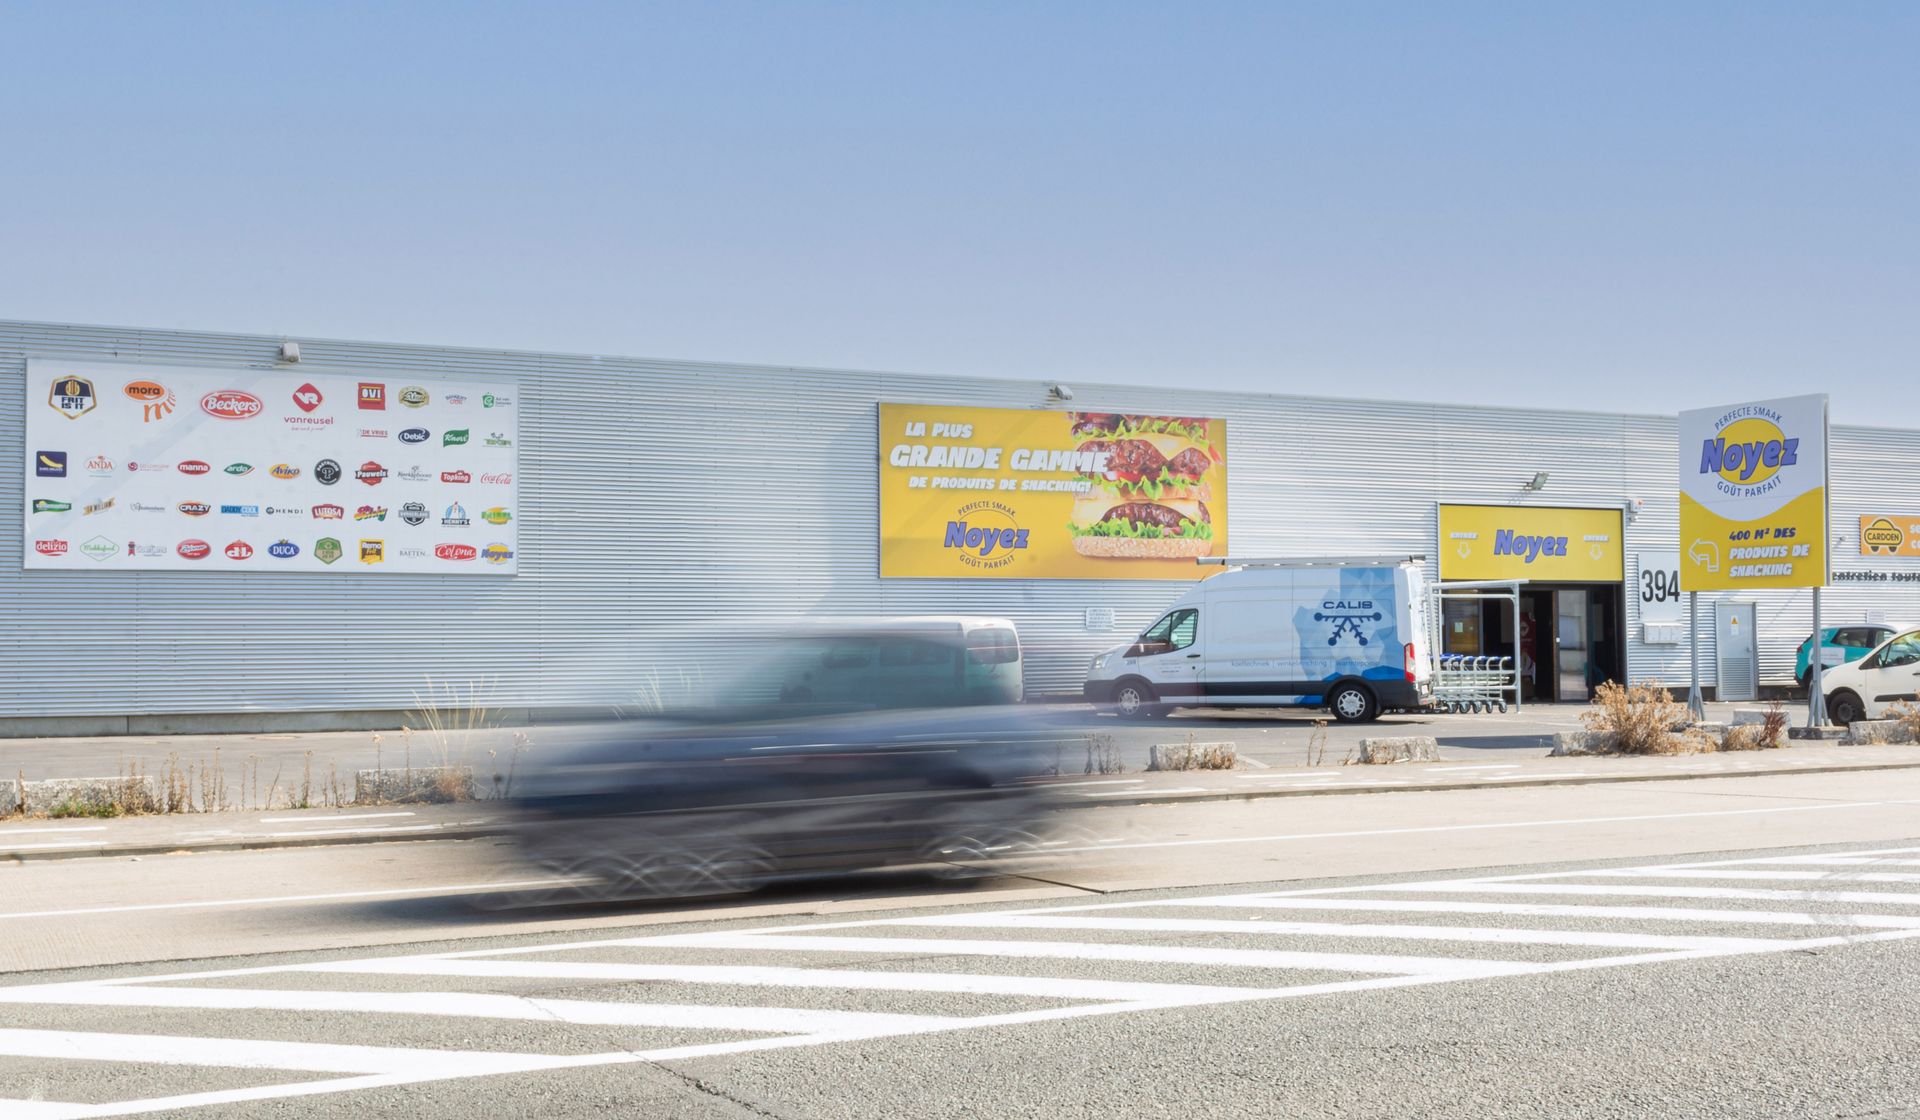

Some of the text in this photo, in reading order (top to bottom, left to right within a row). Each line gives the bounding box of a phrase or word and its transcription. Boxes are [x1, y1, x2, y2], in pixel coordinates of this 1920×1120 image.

[128, 385, 161, 396] mora
[361, 388, 381, 399] OVI
[207, 396, 258, 414] Beckers
[284, 416, 334, 425] vanreusel
[1714, 406, 1783, 431] PERFECTE SMAAK
[403, 431, 426, 441] Debic
[905, 422, 973, 438] LA PLUS
[88, 460, 113, 470] ANDA
[890, 444, 1111, 472] GRANDE GAMME
[1700, 438, 1800, 481] Noyez
[179, 463, 208, 472] manna
[226, 464, 249, 472] ardo
[271, 465, 300, 475] Aviko
[908, 476, 1092, 492] DE PRODUITS DE SNACKING!
[1717, 475, 1782, 498] GOÛT PARFAIT
[180, 503, 211, 512] CRAZY
[957, 501, 1016, 517] PERFECTE SMAAK
[944, 521, 1030, 556] Noyez
[1729, 530, 1751, 541] 400
[1773, 527, 1796, 539] DES
[1867, 532, 1900, 541] CARDOEN
[36, 541, 67, 551] delizio
[272, 546, 295, 555] DUCA
[1494, 529, 1568, 563] Noyez
[1729, 543, 1811, 560] PRODUITS DE
[959, 554, 1015, 569] GOÛT PARFAIT
[1729, 563, 1793, 577] SNACKING
[1832, 570, 1887, 581] entretien
[1641, 569, 1681, 602] 394
[1322, 601, 1373, 609] CALIS
